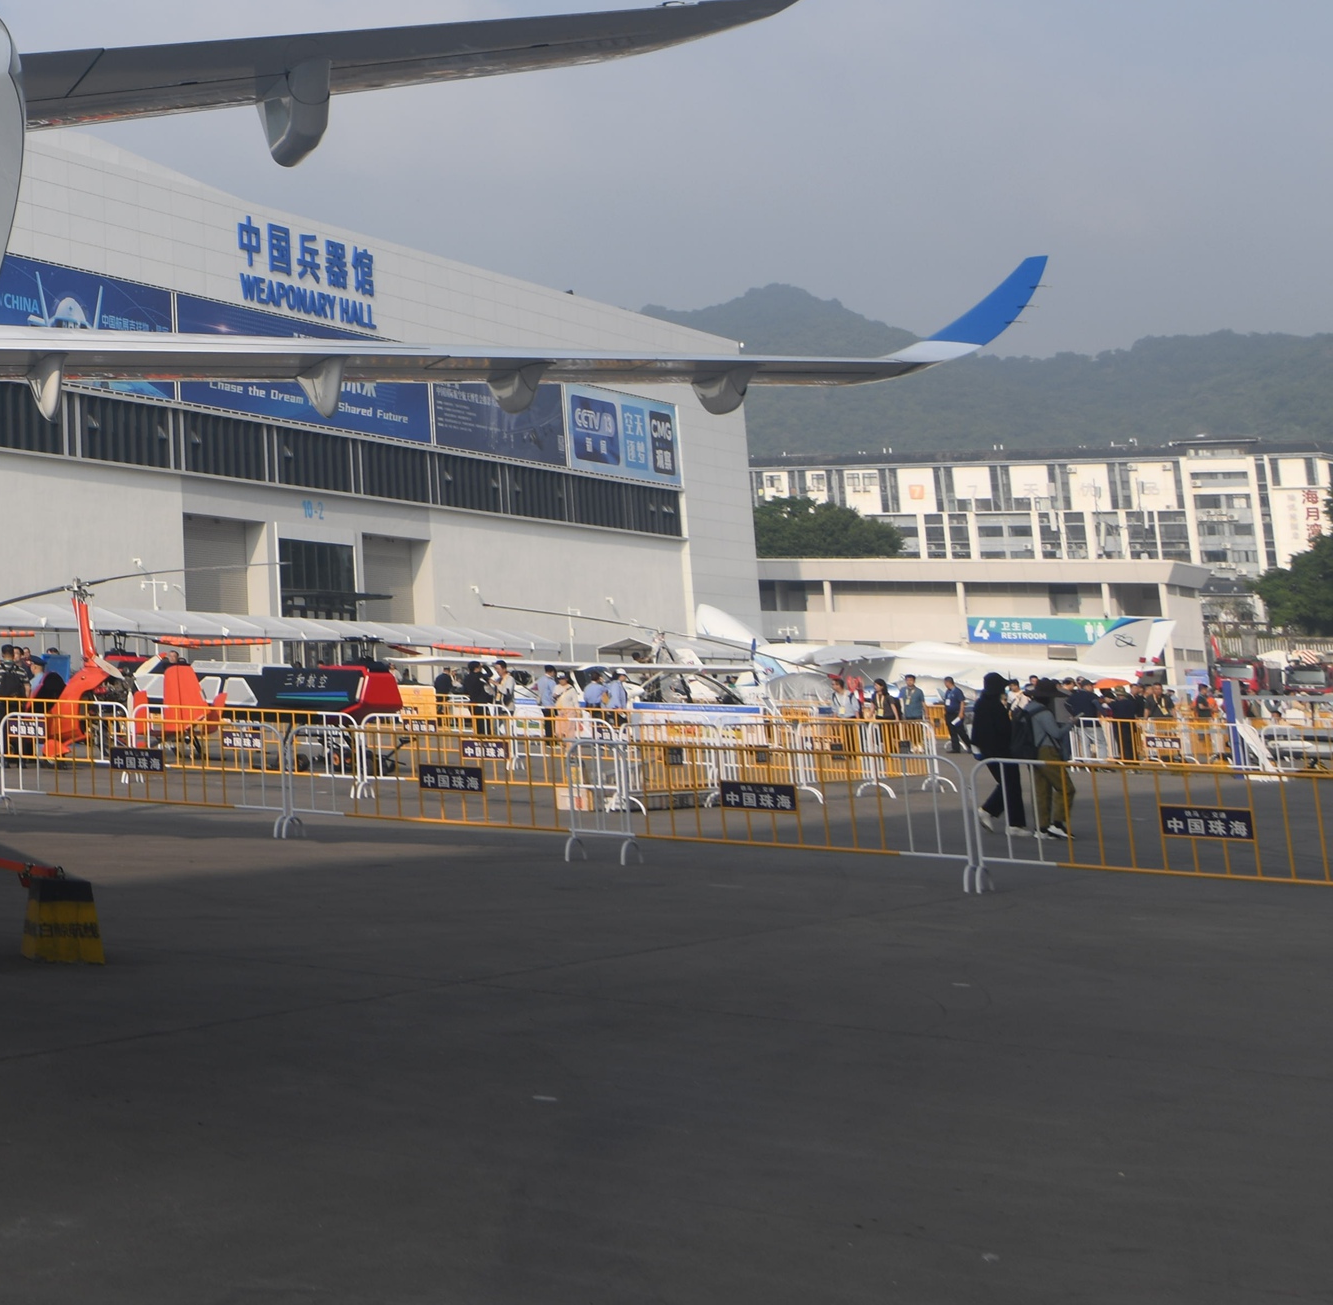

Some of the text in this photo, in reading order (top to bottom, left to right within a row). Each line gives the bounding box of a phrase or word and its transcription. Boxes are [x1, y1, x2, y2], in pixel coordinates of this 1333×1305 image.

[237, 215, 374, 297] 中国兵器馆
[239, 273, 377, 330] WEAPONARY HALL
[210, 382, 243, 394] Chase
[248, 385, 265, 397] the
[270, 391, 303, 405] Dream
[338, 402, 409, 424] Shared Future
[575, 408, 613, 433] CCTV 13
[624, 412, 644, 436] 空天
[651, 419, 672, 441] CMG
[1302, 490, 1322, 549] 海月湾
[1001, 621, 1032, 631] 卫生间
[1001, 632, 1047, 640] RESTROOM
[223, 736, 262, 748] 中国珠海
[464, 746, 506, 758] 中国珠海
[114, 755, 161, 770] 中国珠海
[423, 773, 479, 790] 中国珠海
[726, 792, 792, 809] 中国珠海
[1167, 817, 1248, 837] 中国珠海
